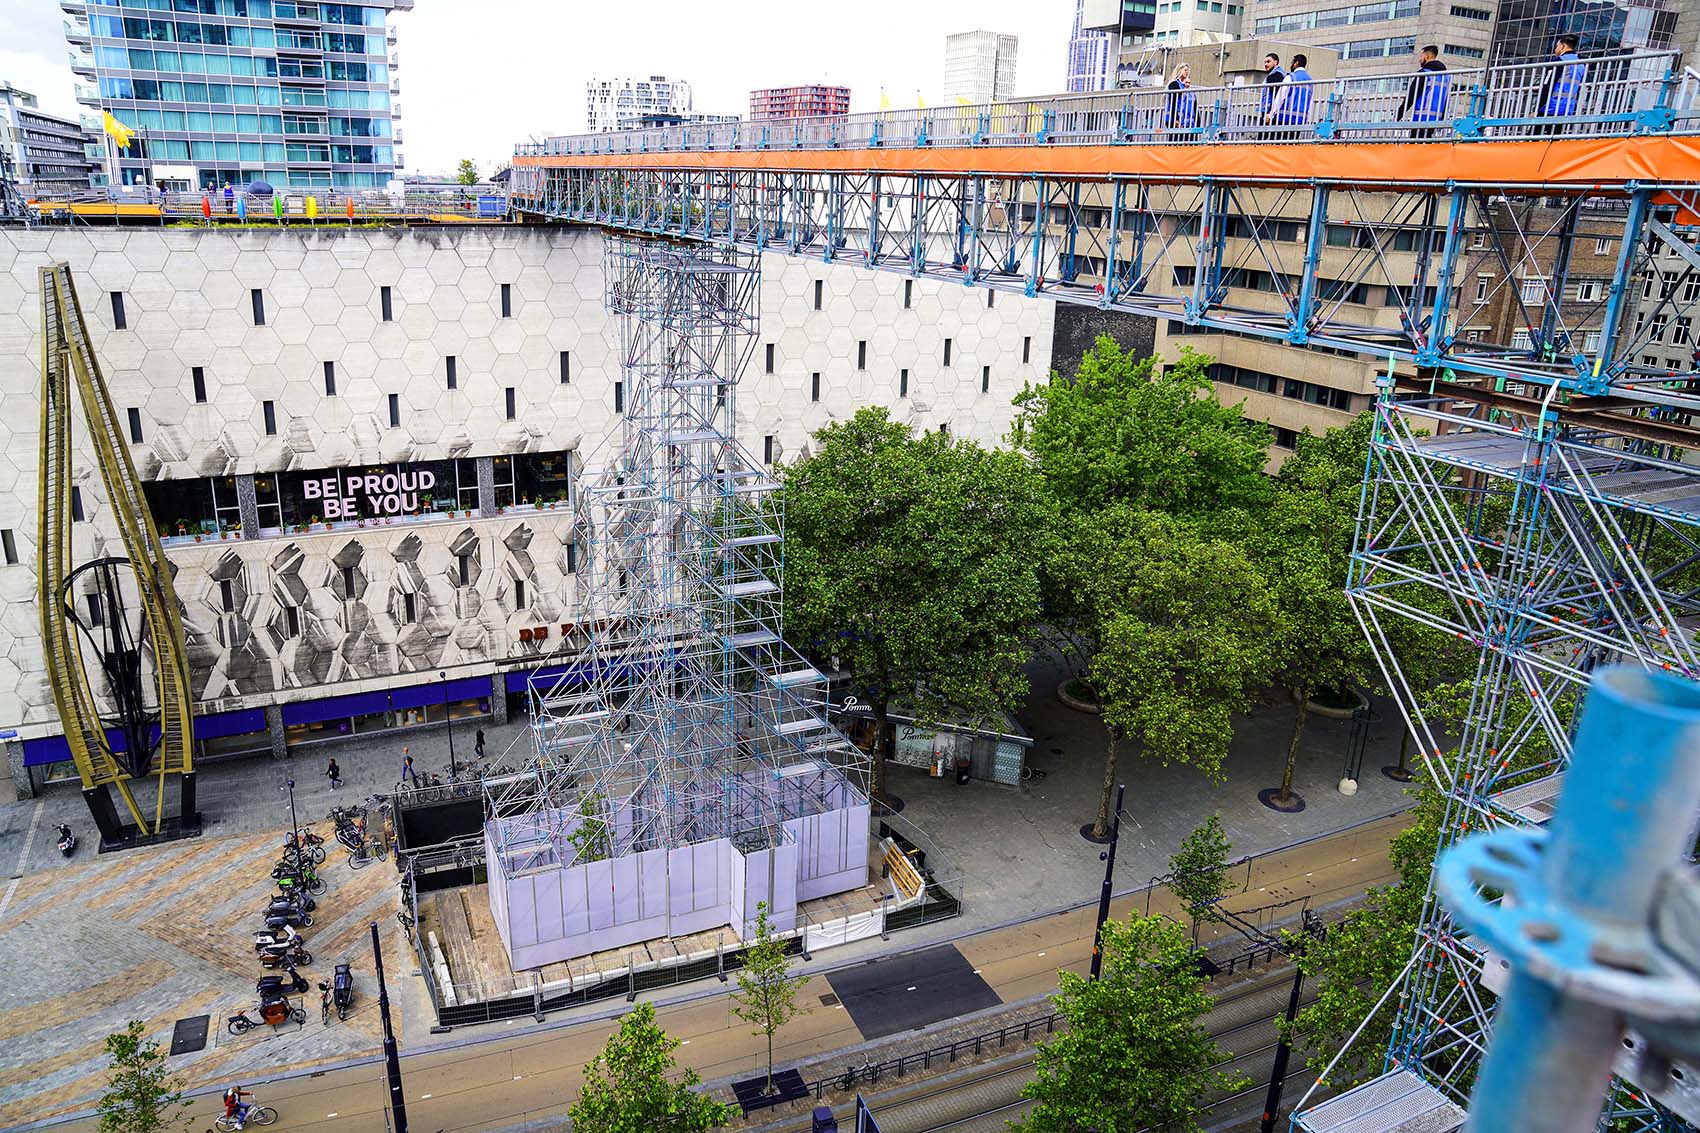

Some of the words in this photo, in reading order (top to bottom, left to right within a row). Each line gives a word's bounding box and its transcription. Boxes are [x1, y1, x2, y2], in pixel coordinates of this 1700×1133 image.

[303, 478, 339, 499] BE
[346, 470, 436, 496] PROUD
[323, 497, 359, 518] BE
[367, 492, 418, 514] YOU
